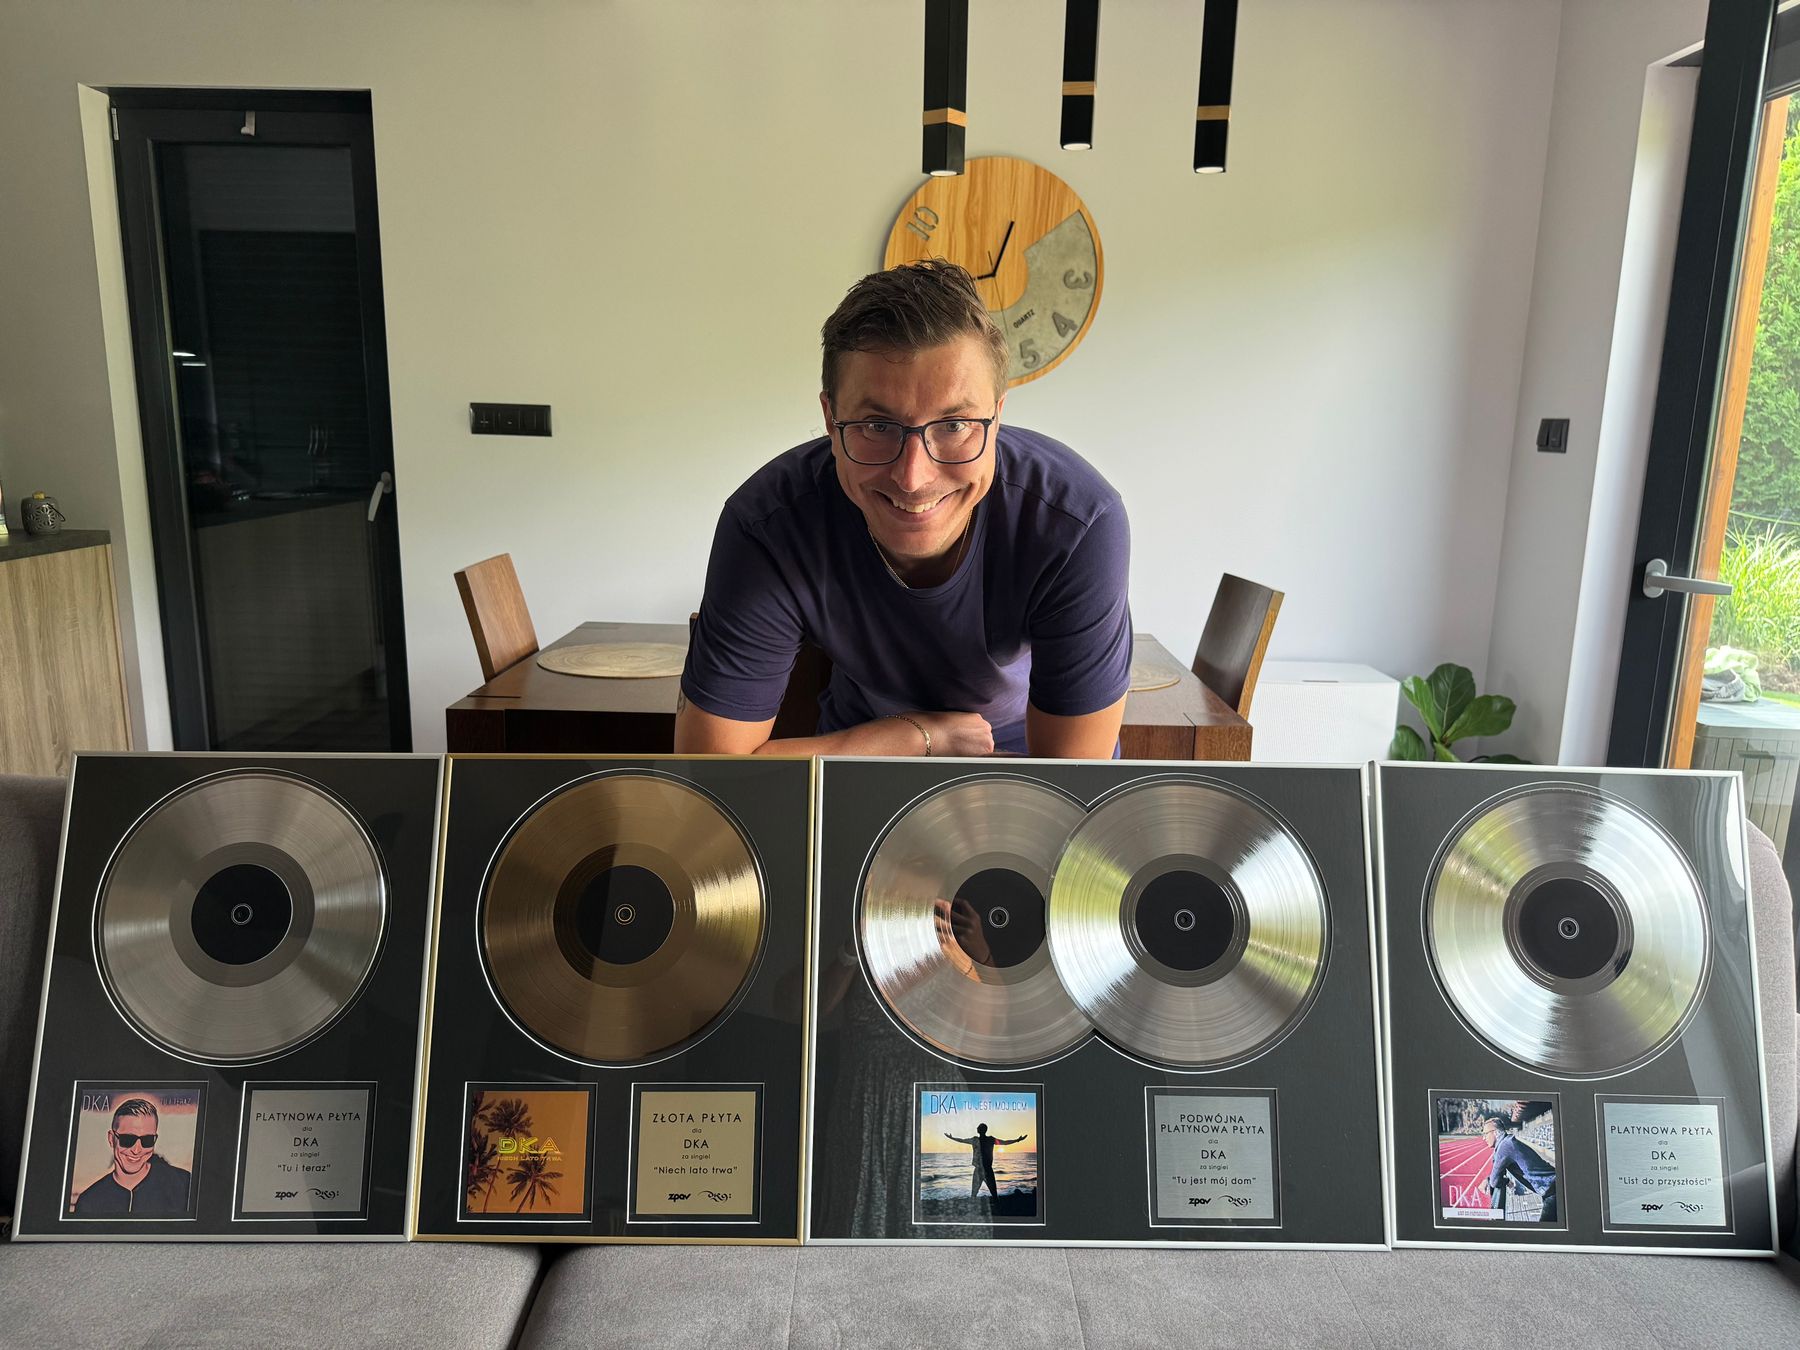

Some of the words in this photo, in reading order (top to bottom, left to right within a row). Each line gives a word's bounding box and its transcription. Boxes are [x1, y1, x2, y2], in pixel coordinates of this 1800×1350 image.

[1062, 268, 1093, 290] 3
[1013, 308, 1035, 329] QUARTZ
[1052, 311, 1078, 338] 4
[1019, 338, 1041, 369] 5
[82, 1095, 110, 1112] DKA
[930, 1094, 957, 1114] DKA
[256, 1113, 323, 1121] PLATYNOWA
[328, 1113, 360, 1121] PŁYTA
[652, 1113, 694, 1123] ZŁOTA
[701, 1113, 741, 1123] PŁYTA
[1180, 1113, 1245, 1124] PODWÓJNA
[1161, 1124, 1228, 1133] PLATYNOWA
[1233, 1125, 1264, 1134] PŁYTA
[1610, 1126, 1677, 1135] PLATYNOWA
[1682, 1127, 1713, 1135] PŁYTA
[293, 1137, 319, 1147] DKA
[498, 1136, 561, 1154] DKA
[684, 1139, 709, 1149] DKA
[1201, 1150, 1226, 1159] DKA
[1651, 1150, 1676, 1160] DKA
[690, 1166, 708, 1174] lato
[1190, 1177, 1207, 1185] jest
[1211, 1177, 1228, 1186] mój
[275, 1191, 298, 1200] zpav
[668, 1193, 691, 1202] zpav
[1449, 1185, 1482, 1207] DKA
[1189, 1198, 1211, 1206] zpav
[1641, 1204, 1663, 1212] zpav
